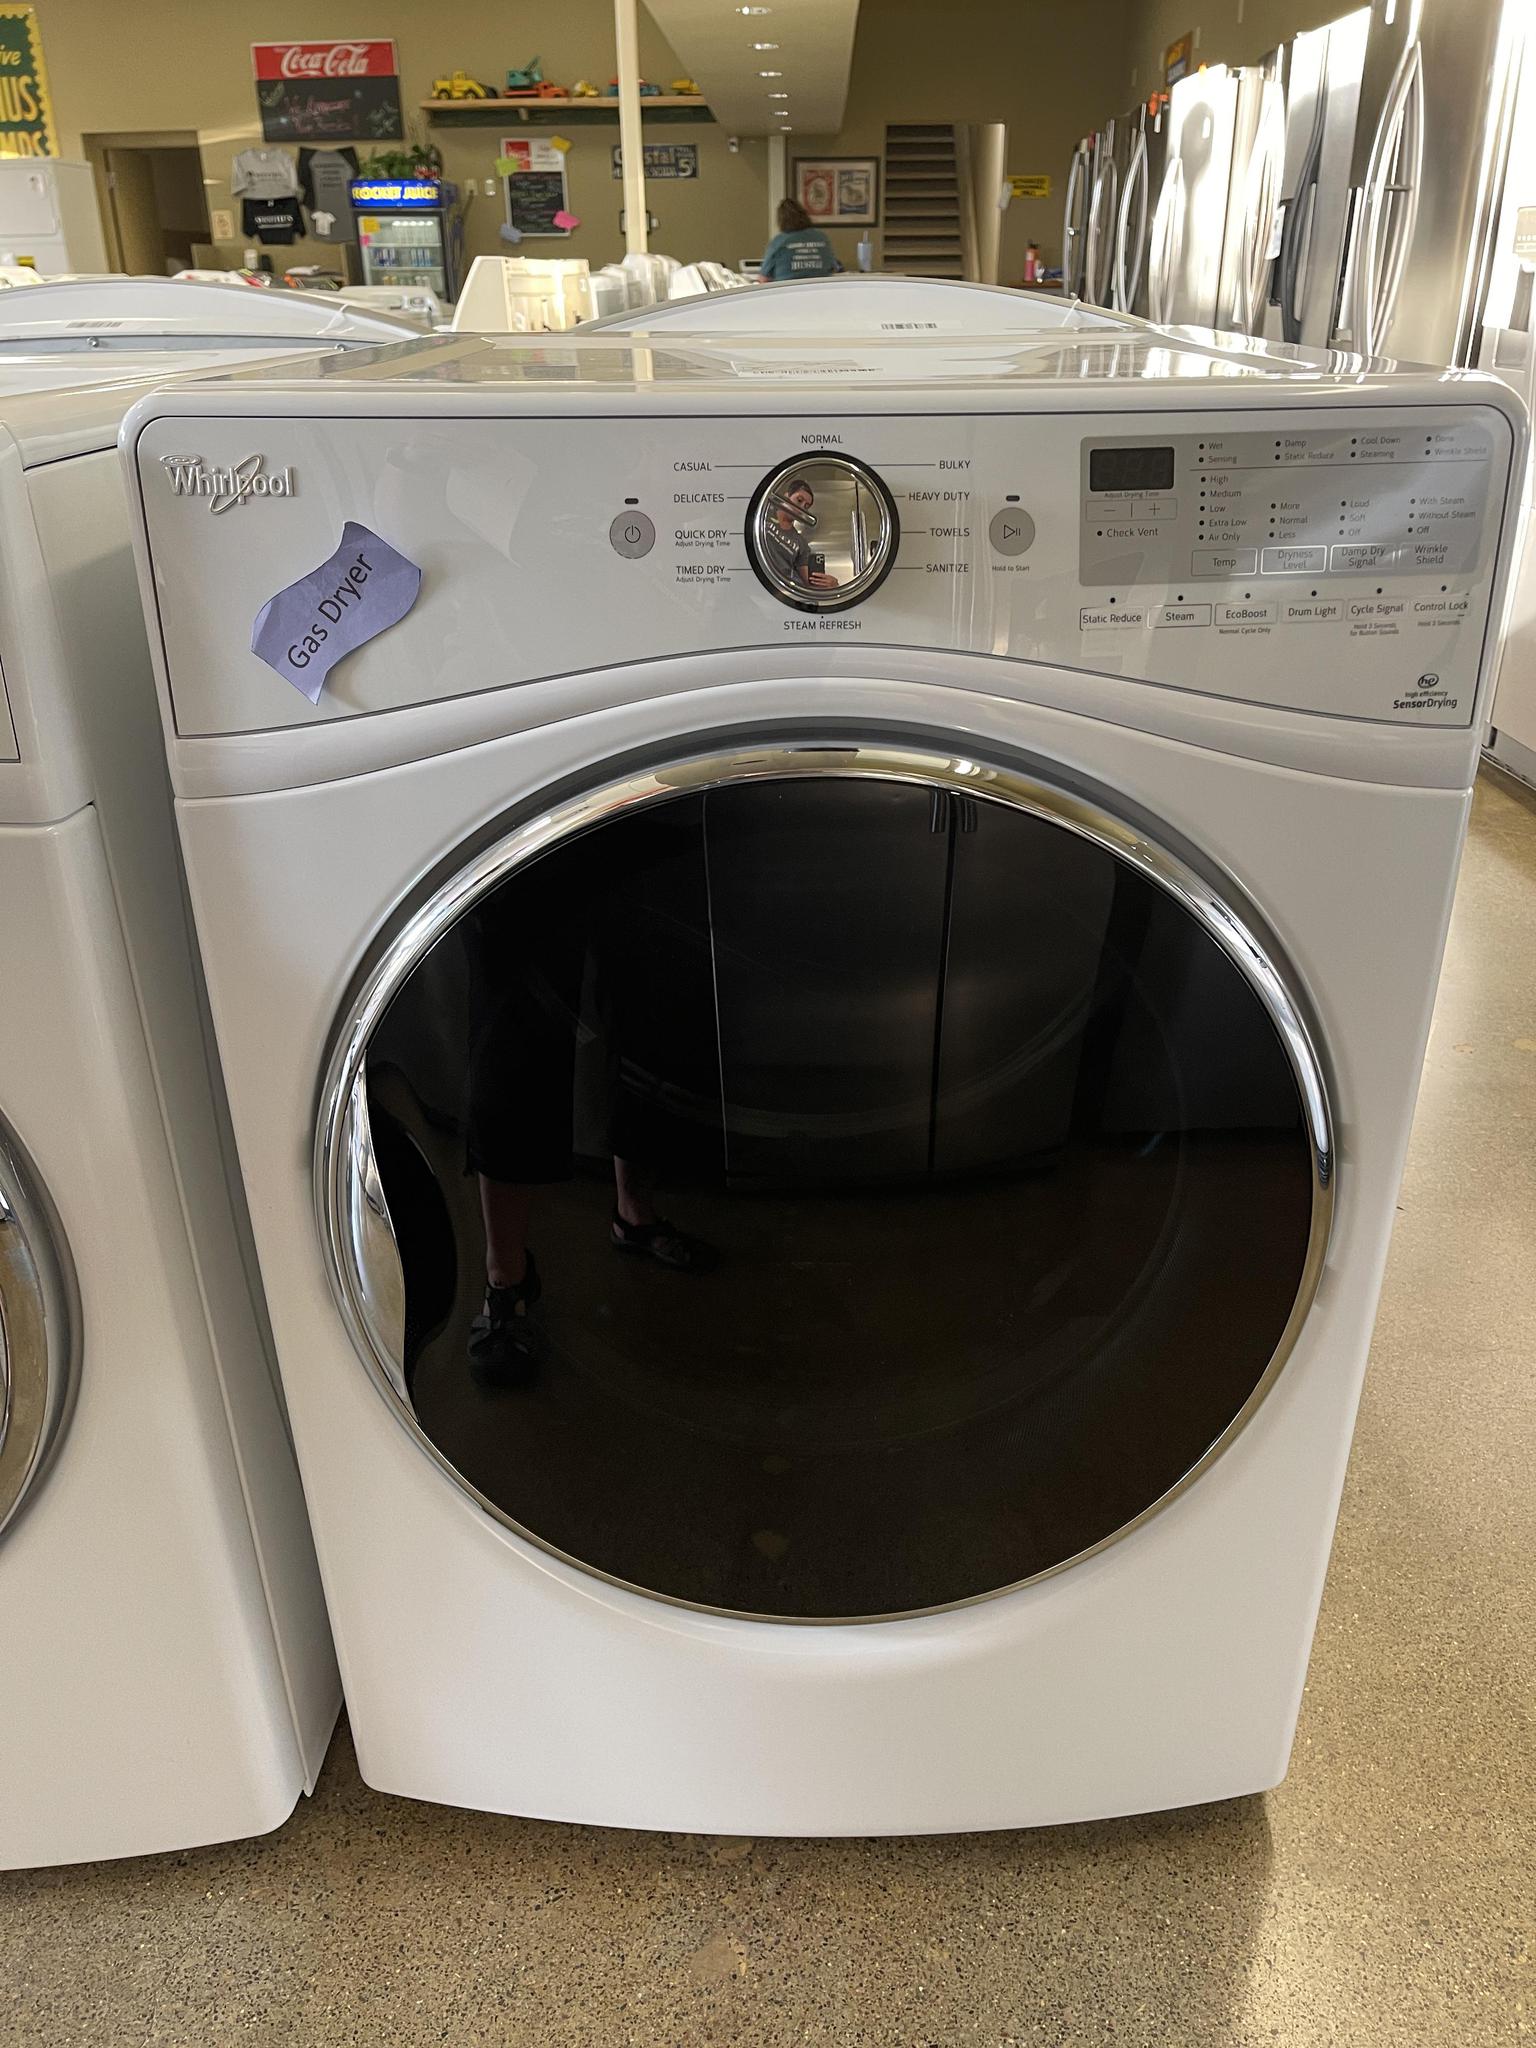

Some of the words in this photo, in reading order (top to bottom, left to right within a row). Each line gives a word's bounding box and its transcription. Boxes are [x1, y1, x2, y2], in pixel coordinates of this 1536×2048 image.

[801, 434, 844, 444] NORMAL
[1285, 440, 1307, 448] Damp
[1361, 437, 1379, 445] Cool
[1380, 436, 1400, 444] Down
[1208, 442, 1223, 450] Wet
[1285, 452, 1305, 461] Static
[673, 462, 712, 472] CASUAL
[939, 460, 970, 470] BULKY
[162, 463, 297, 506] Whirlpool
[1210, 475, 1229, 485] High
[673, 493, 725, 503] DELICATES
[908, 491, 940, 501] HEAVY
[943, 491, 970, 501] DUTY
[1209, 489, 1242, 498] Medium
[1209, 504, 1226, 513] Low
[1280, 502, 1301, 511] More
[1418, 511, 1449, 520] Without
[1451, 510, 1476, 519] Steam
[1209, 518, 1229, 527] Extra
[1231, 518, 1248, 527] Low
[1279, 516, 1308, 526] Normal
[675, 530, 706, 539] QUICK
[708, 530, 727, 539] DRY
[929, 527, 970, 537] TOWELS
[1106, 528, 1135, 538] Check
[1137, 527, 1158, 537] Vent
[1416, 525, 1430, 535] Off
[1208, 533, 1219, 542] Air
[1221, 532, 1241, 543] Only
[1278, 531, 1296, 540] Less
[675, 541, 694, 549] Adjust
[695, 541, 715, 549] Drying
[1414, 544, 1449, 555] Wrinkle
[1278, 550, 1313, 561] Dryness
[1341, 547, 1368, 558] Damp
[1369, 546, 1386, 557] Dry
[1212, 557, 1237, 569] Temp
[1283, 559, 1307, 570] Level
[1348, 557, 1377, 569] Signal
[1416, 555, 1445, 566] Shield
[676, 566, 704, 575] TIMED
[706, 566, 725, 575] DRY
[926, 563, 969, 573] SANITIZE
[991, 564, 1007, 572] Hold
[1015, 564, 1030, 572] Start
[676, 577, 694, 585] Adjust
[695, 576, 715, 584] Drying
[716, 575, 732, 583] Time
[287, 623, 329, 669] Gas
[317, 553, 373, 624] Dryer
[1350, 604, 1375, 616] Cycle
[1376, 603, 1404, 616] Signal
[1414, 602, 1447, 612] Control
[1449, 601, 1469, 611] Lock
[1165, 611, 1195, 622] Steam
[1224, 609, 1267, 620] EcoBoost
[1288, 607, 1312, 617] Drum
[1314, 606, 1337, 619] Light
[1082, 614, 1108, 624] Static
[1109, 613, 1142, 623] Reduce
[783, 621, 817, 631] STEAM
[819, 620, 862, 630] REFRESH
[1257, 627, 1271, 635] Only
[1392, 698, 1458, 710] SensorDrying
